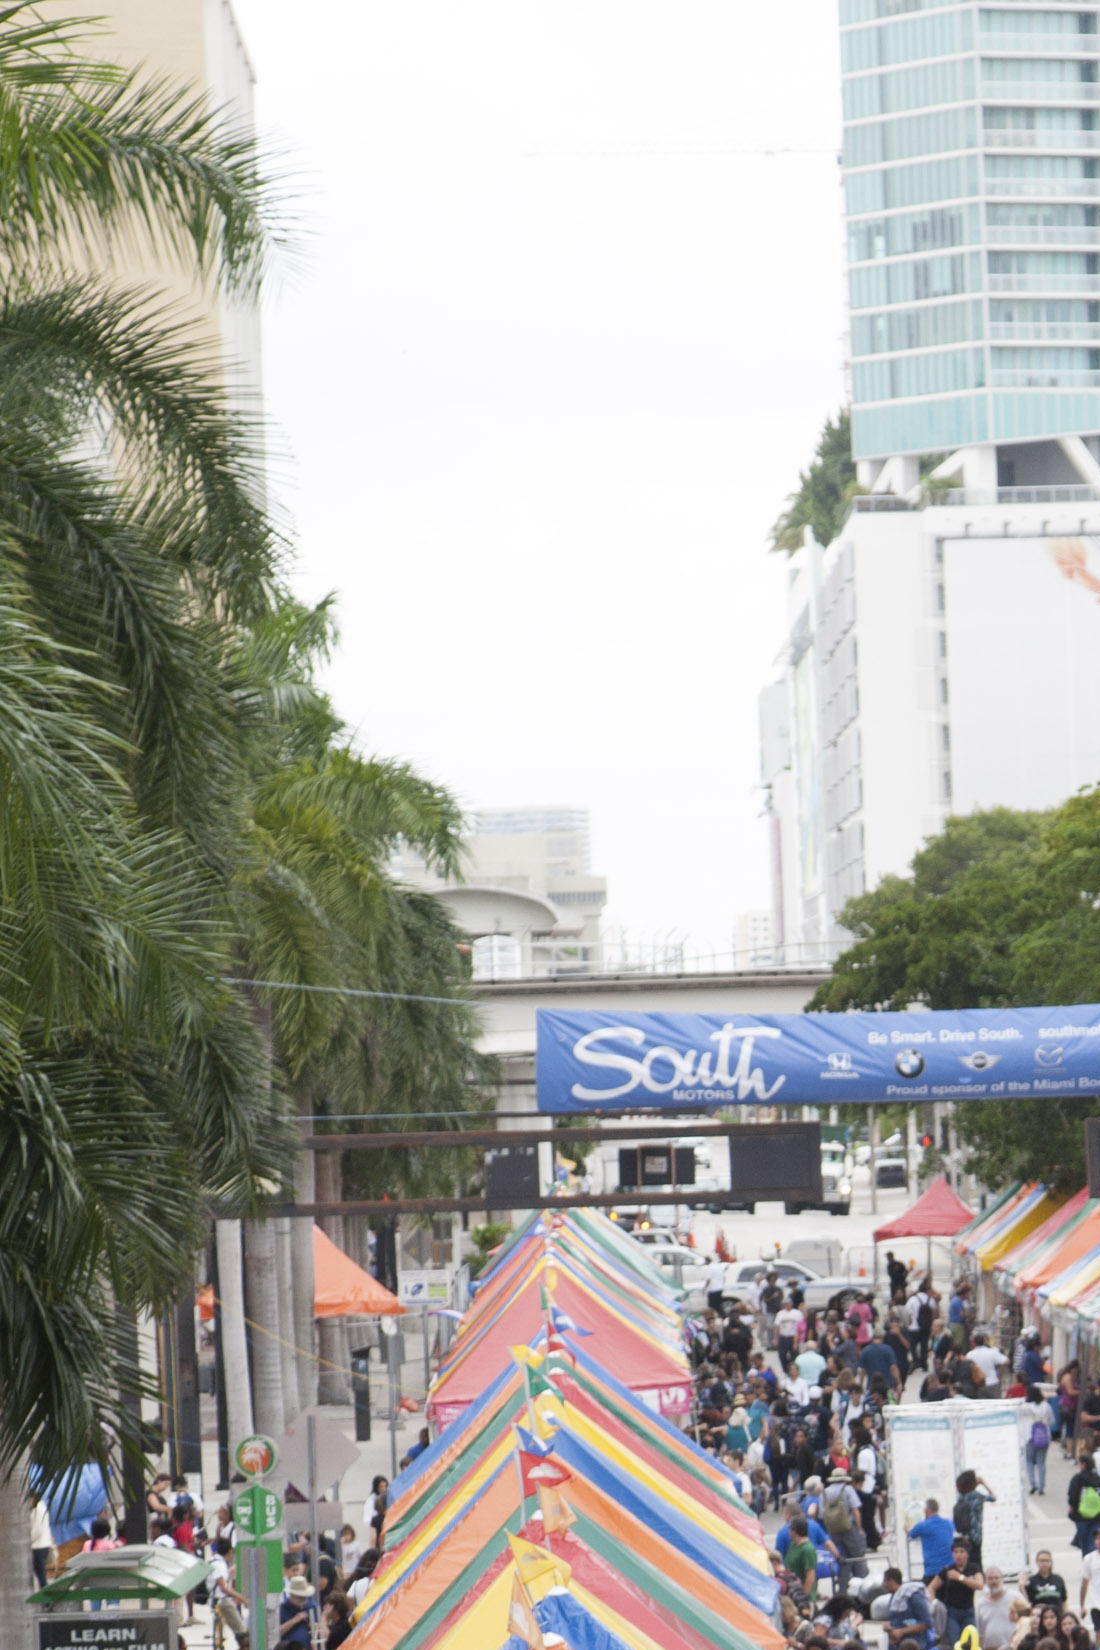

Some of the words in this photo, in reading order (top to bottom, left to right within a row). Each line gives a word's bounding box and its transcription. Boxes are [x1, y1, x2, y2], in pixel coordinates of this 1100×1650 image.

[868, 1031, 888, 1044] Be
[890, 1029, 936, 1043] Smart.
[939, 1028, 976, 1042] Drive
[979, 1026, 1024, 1041] South.
[571, 1022, 786, 1101] South
[673, 1089, 735, 1100] MOTORS
[886, 1084, 928, 1096] Proud
[931, 1081, 988, 1096] sponsor
[990, 1080, 1005, 1092] of
[1008, 1078, 1031, 1091] the
[1034, 1076, 1077, 1090] Miami
[265, 1495, 277, 1527] BUS
[70, 1628, 136, 1643] LEARN
